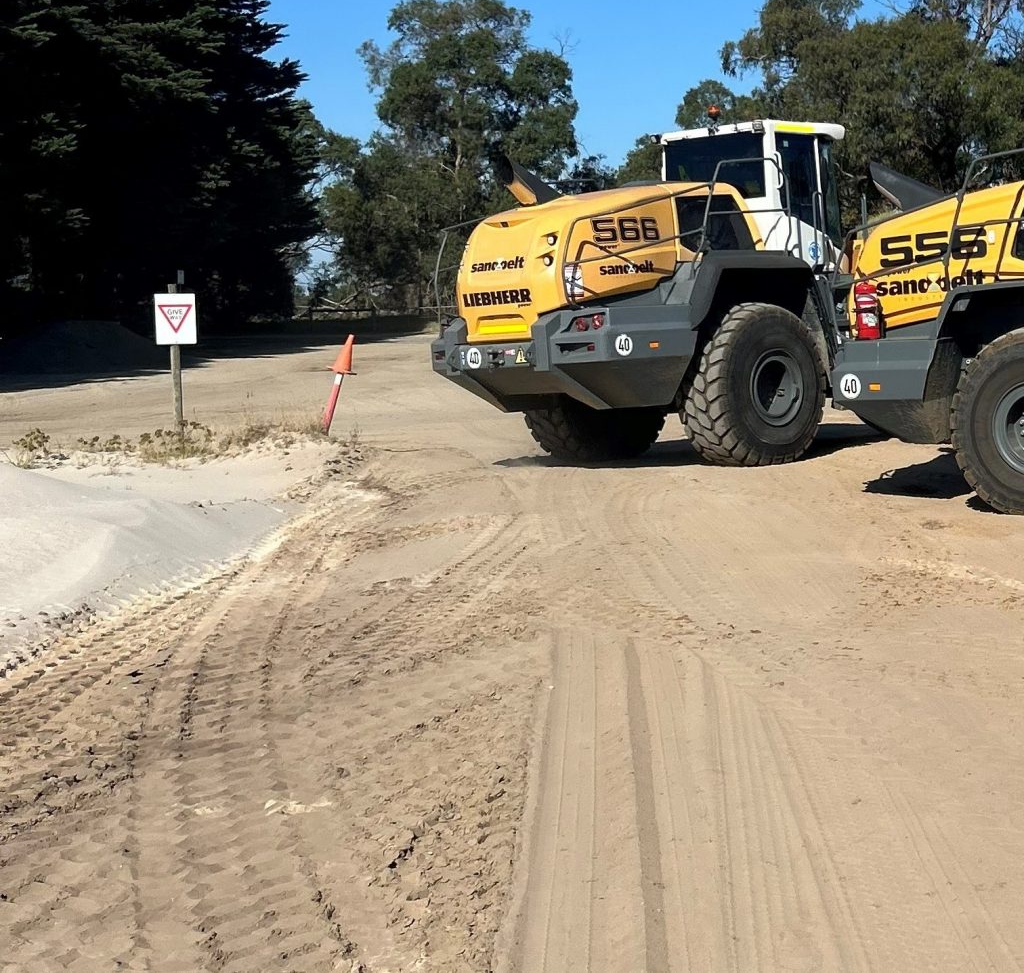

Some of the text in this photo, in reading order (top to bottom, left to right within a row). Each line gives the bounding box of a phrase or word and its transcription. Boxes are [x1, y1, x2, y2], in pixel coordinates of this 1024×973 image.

[590, 217, 660, 244] 566
[880, 227, 987, 268] 556
[463, 288, 532, 307] LIEBHERR
[619, 338, 630, 351] 40
[469, 352, 479, 364] 40
[844, 379, 857, 394] 40
